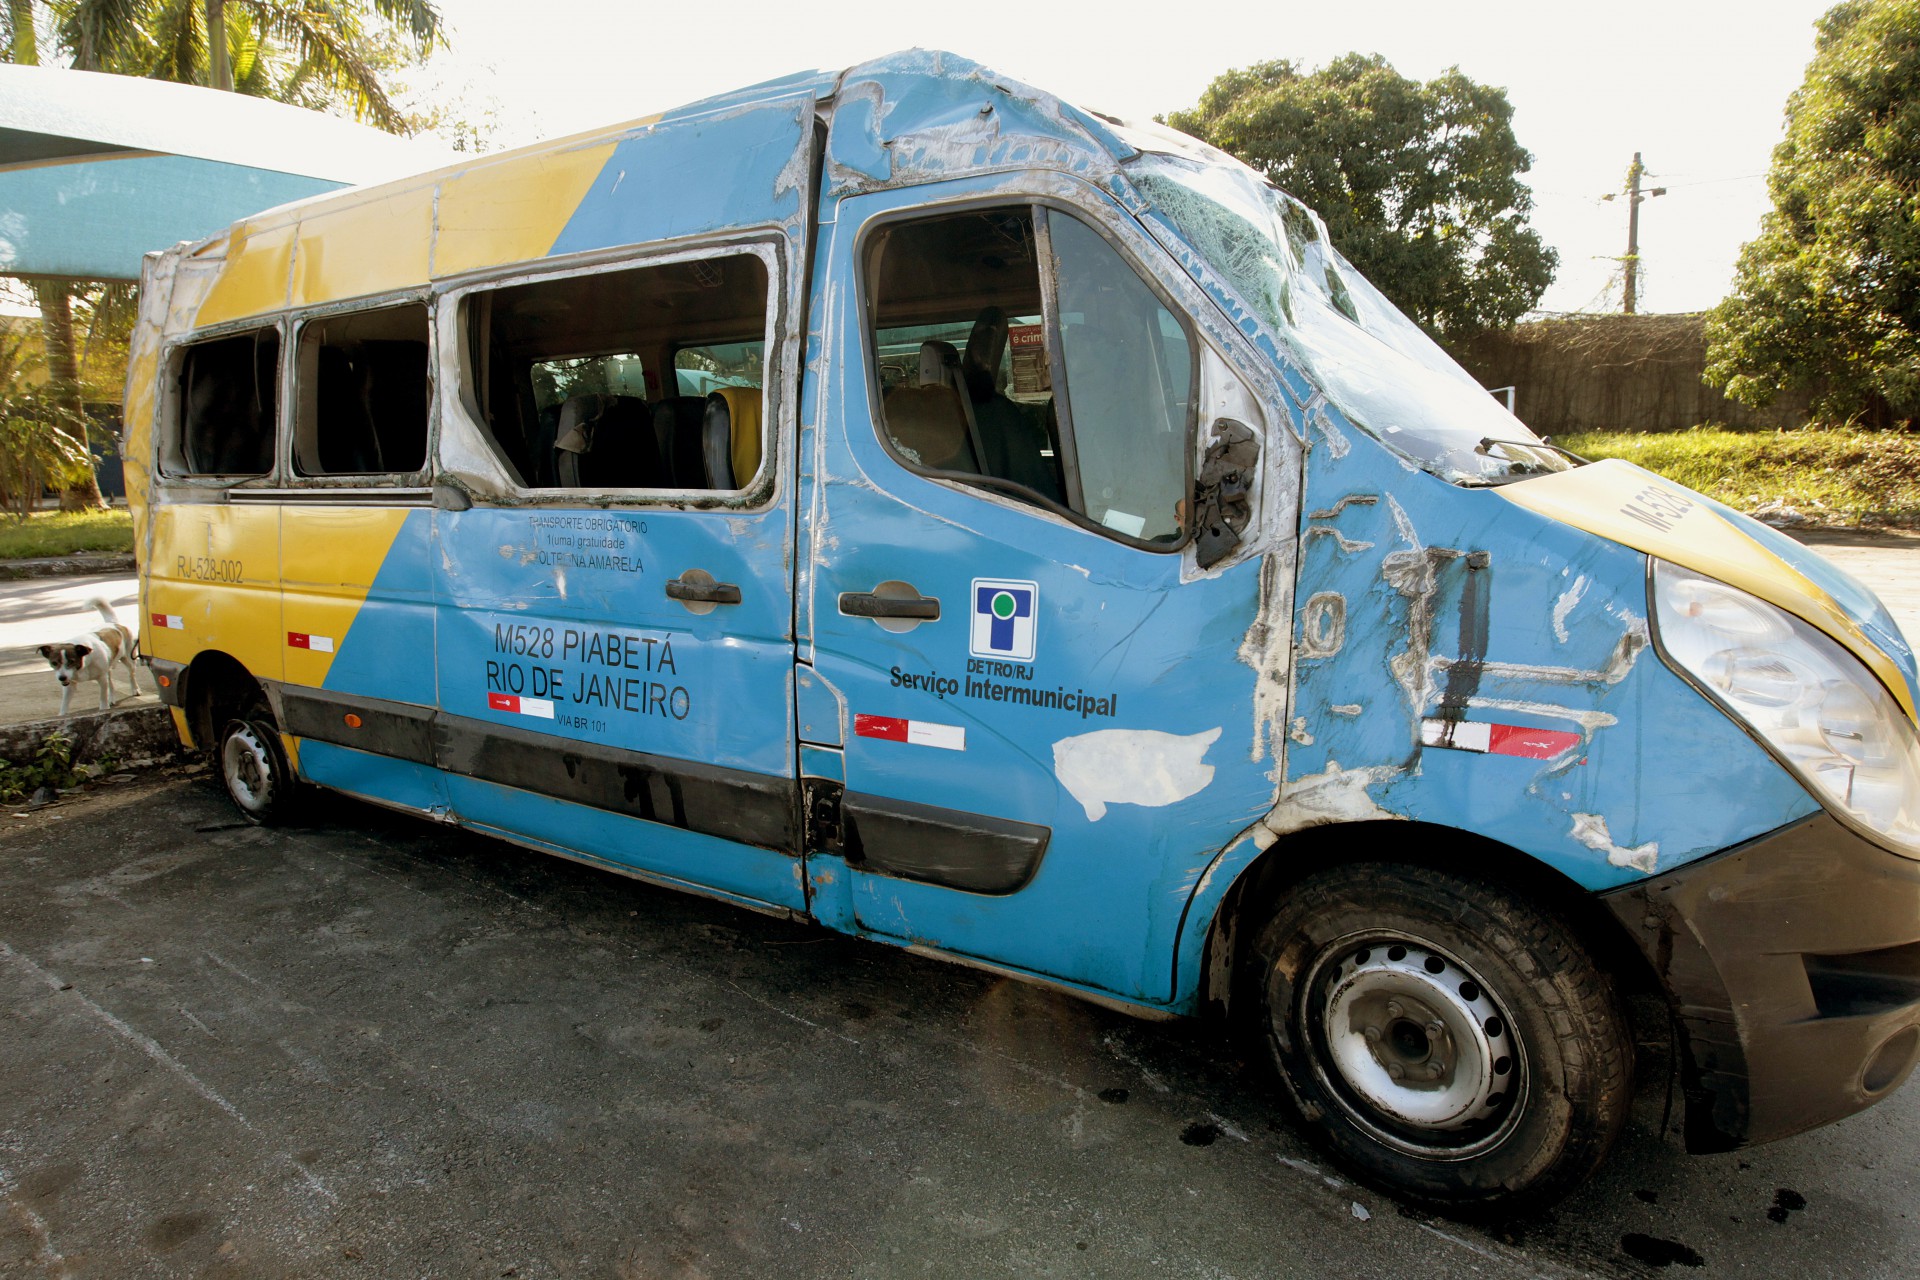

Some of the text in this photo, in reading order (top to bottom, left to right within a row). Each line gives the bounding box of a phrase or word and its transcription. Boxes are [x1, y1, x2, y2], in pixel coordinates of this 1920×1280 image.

[1021, 332, 1044, 343] crim
[1619, 485, 1694, 533] M-528
[528, 516, 648, 534] TRANSPORTE OBRIGATÓRIO
[547, 534, 625, 550] 1(uma) gratuidade
[177, 555, 244, 584] RJ-528-002
[538, 550, 644, 573] OLTRNA AMARELA
[495, 623, 677, 675] M528 PIABETÁ
[966, 658, 1034, 681] DETRO/RJ
[486, 660, 690, 721] RIO DE JANEIRO
[889, 665, 1118, 719] Serviço Intermunicipal
[557, 714, 607, 733] VIA BR 101
